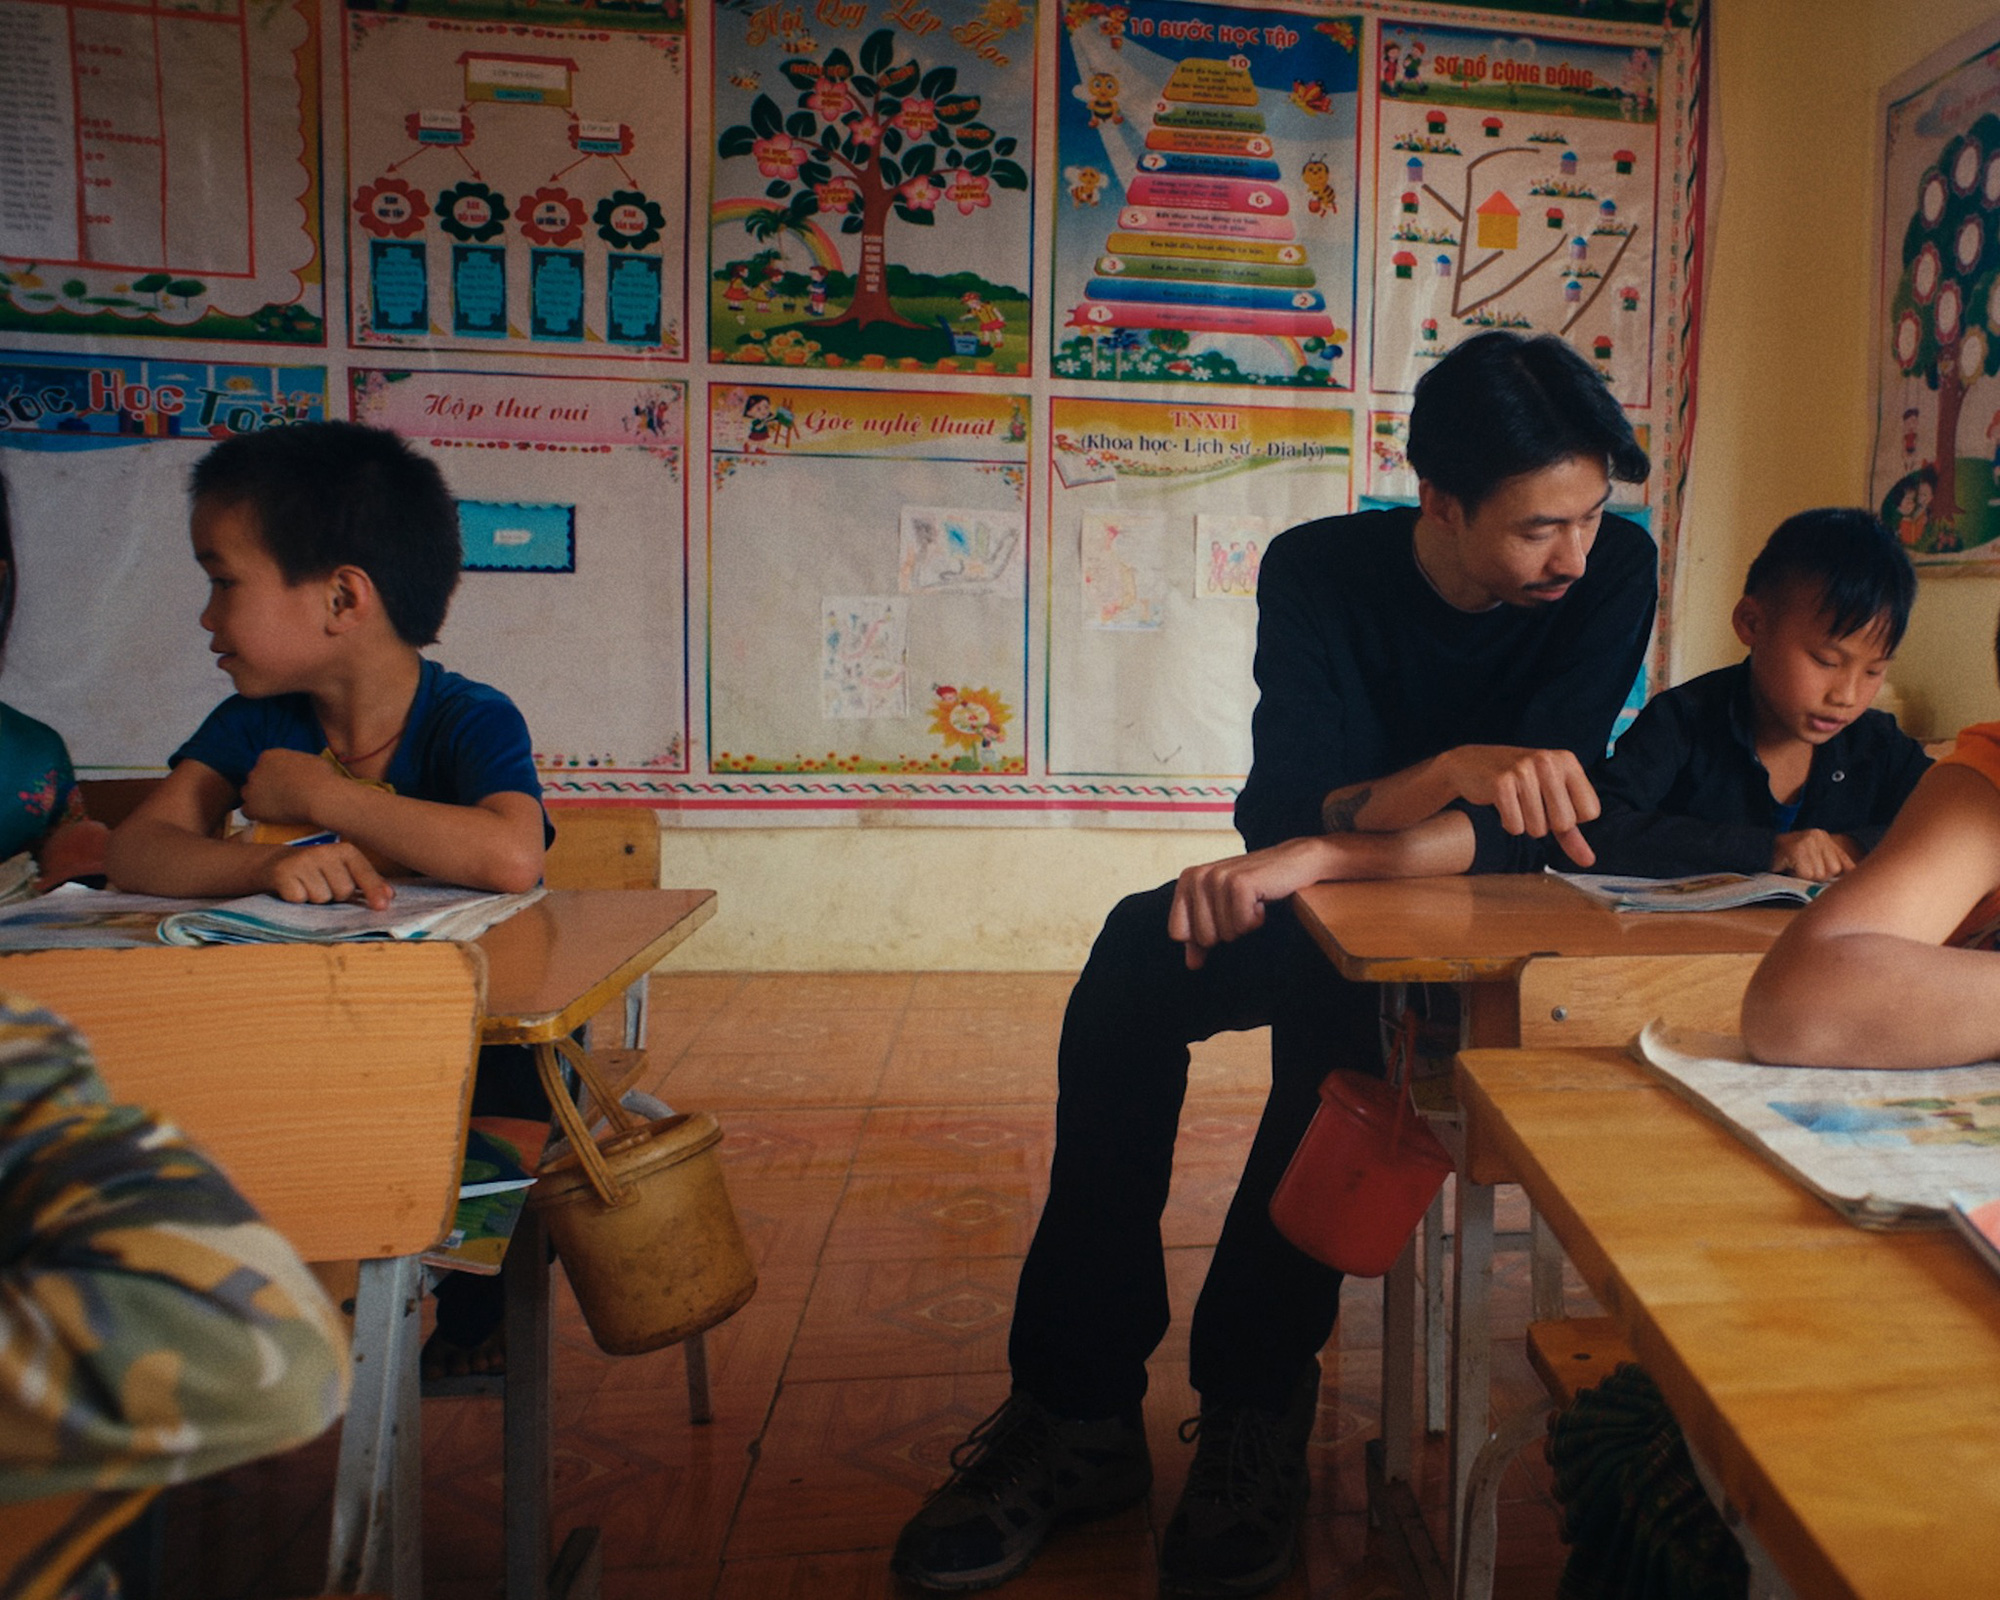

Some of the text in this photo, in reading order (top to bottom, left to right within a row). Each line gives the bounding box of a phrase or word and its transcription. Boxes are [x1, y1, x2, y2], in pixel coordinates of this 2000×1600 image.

[746, 0, 1010, 66] Nội Quy Lớp Học
[1131, 18, 1300, 51] 10 BƯỚC HỌC TẬP
[1230, 58, 1249, 68] 10
[1434, 53, 1594, 88] SƠ ĐỒ CỘNG ĐỒNG
[1157, 102, 1166, 112] 9
[1253, 141, 1262, 152] 8
[1150, 157, 1158, 167] 7
[1255, 195, 1264, 205] 6
[1130, 213, 1139, 224] 5
[1284, 249, 1293, 259] 4
[1108, 259, 1117, 270] 3
[1299, 296, 1308, 306] 2
[1097, 308, 1104, 319] 1
[88, 370, 186, 421] Học
[198, 388, 307, 432] Toá
[424, 394, 590, 422] Hộp thư vui
[804, 408, 996, 440] Góc nghệ thuật
[1171, 411, 1239, 430] TNXH
[1081, 433, 1133, 452] (Khoa
[1184, 438, 1223, 457] Lịch
[1267, 442, 1297, 461] Địa
